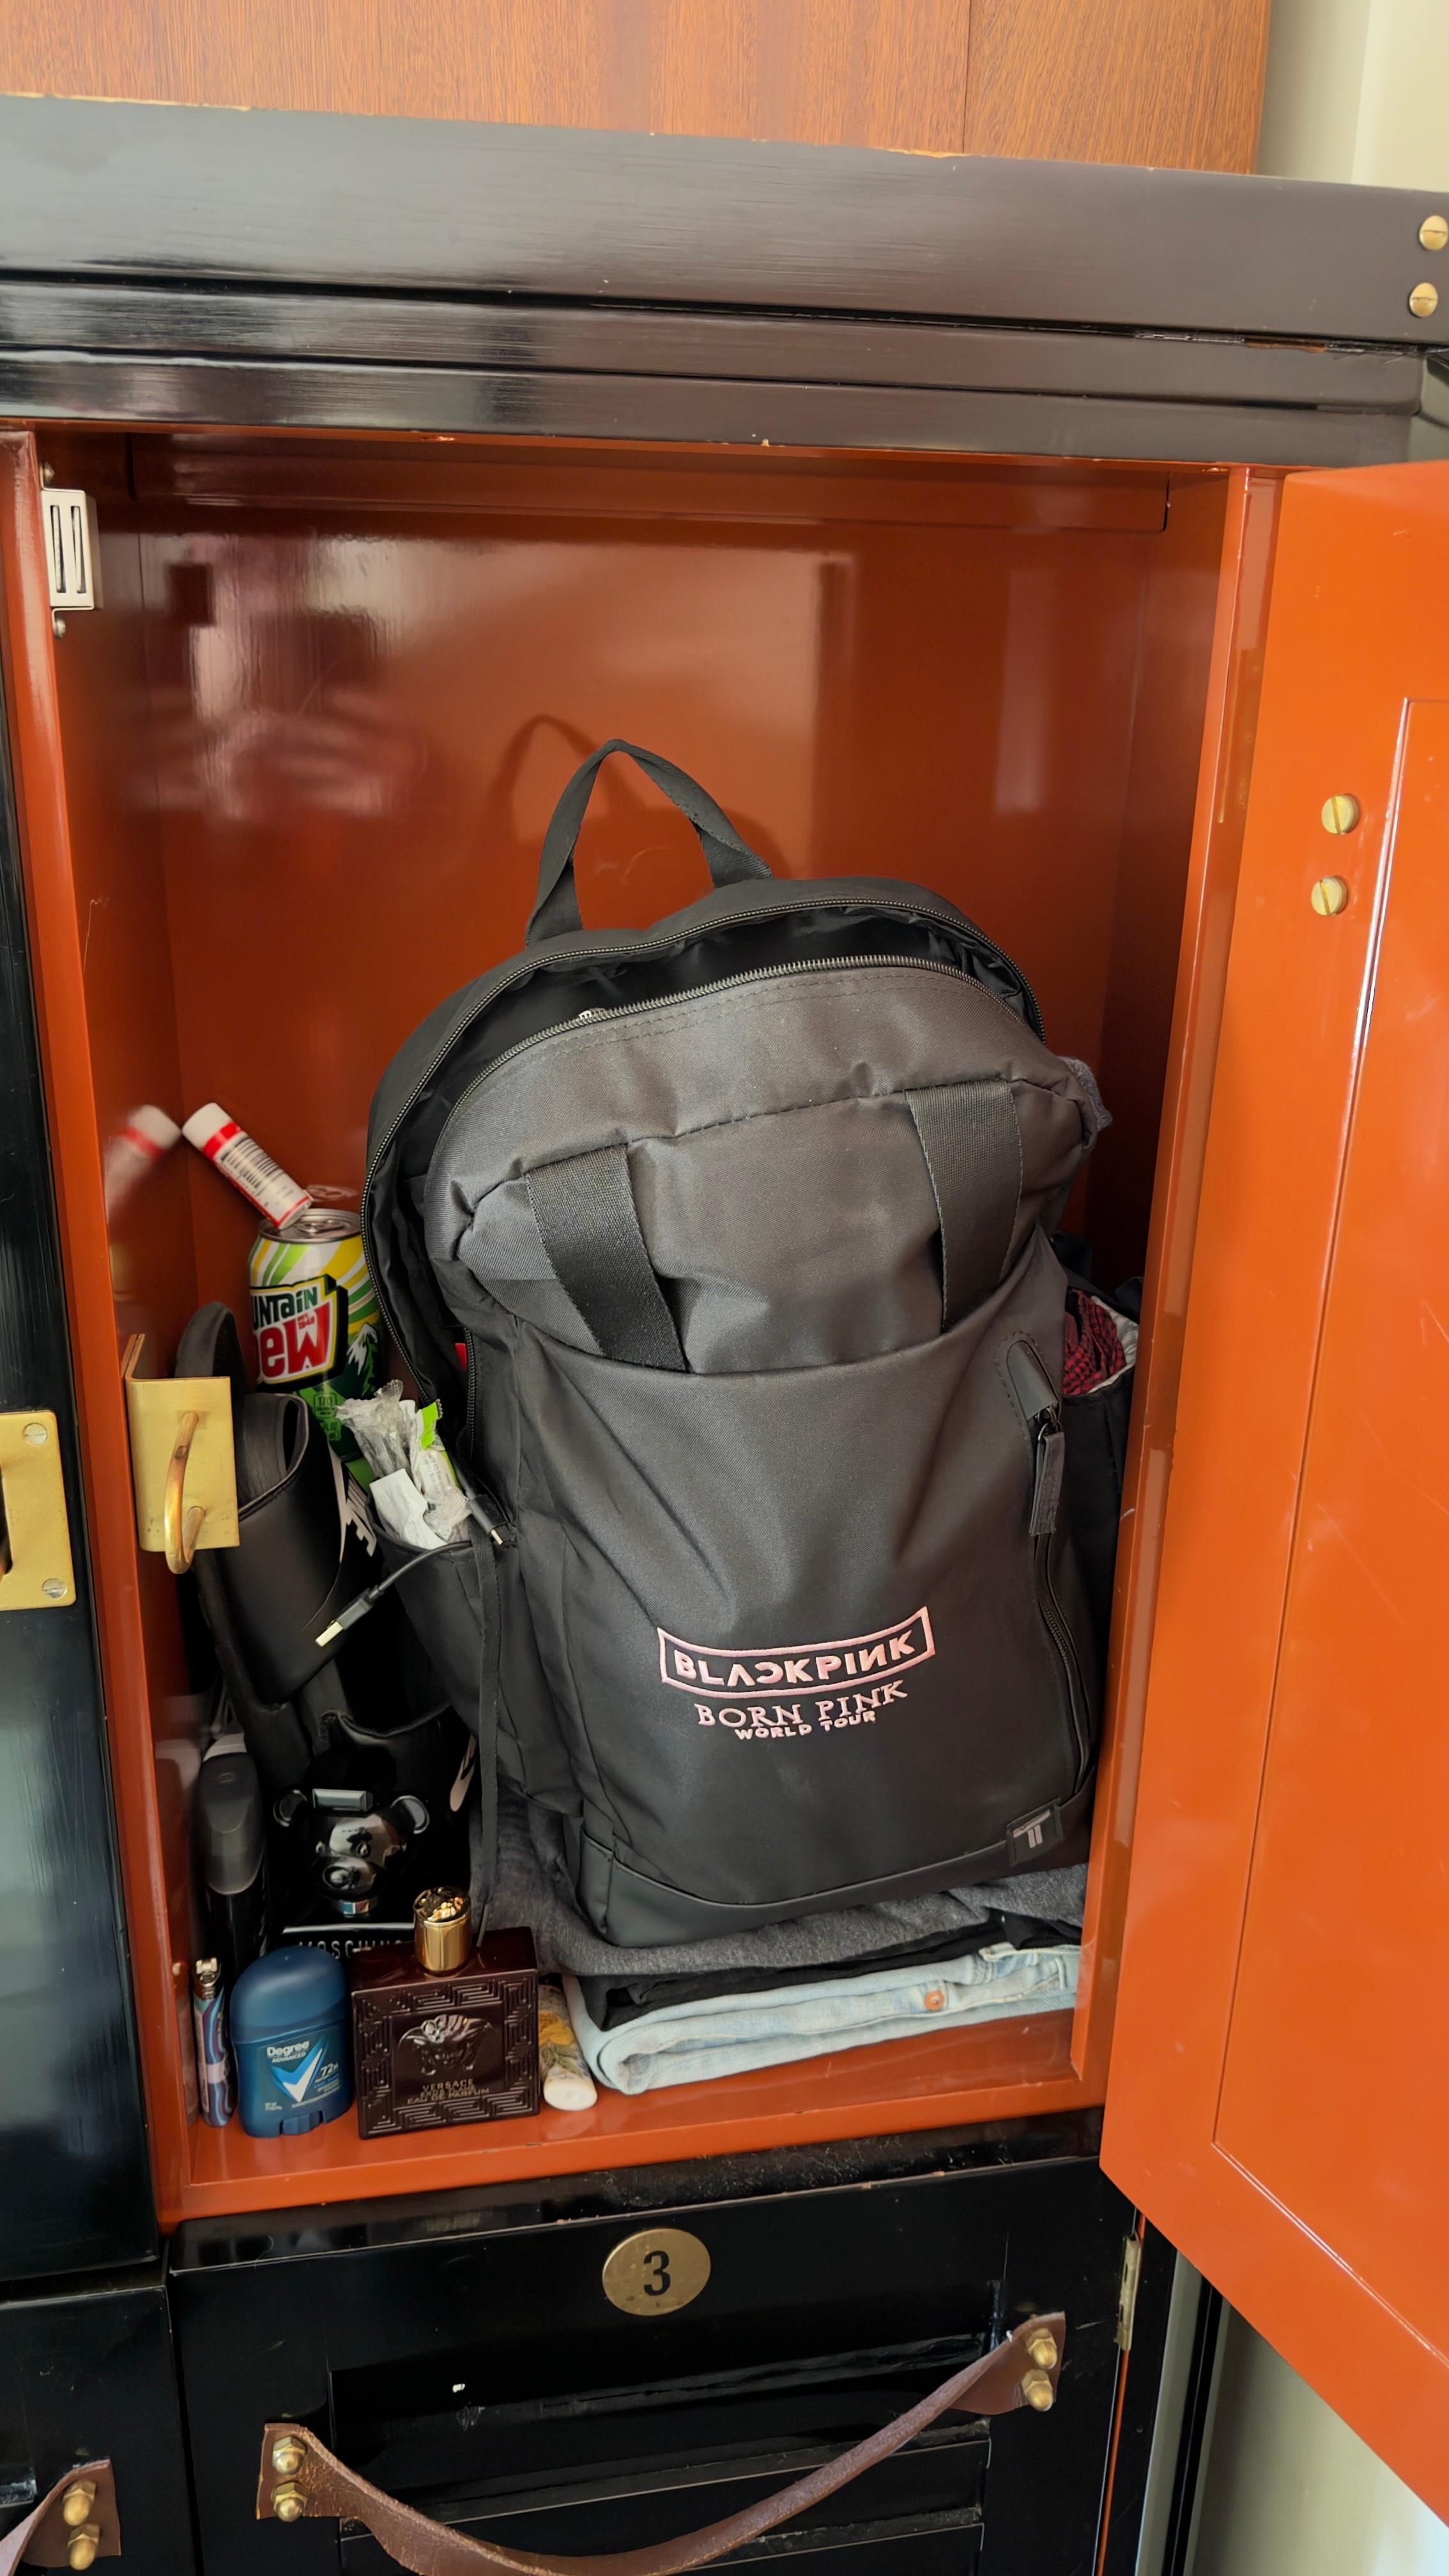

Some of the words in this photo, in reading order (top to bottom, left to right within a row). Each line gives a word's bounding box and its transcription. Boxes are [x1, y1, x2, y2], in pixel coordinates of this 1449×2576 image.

[252, 1286, 318, 1330] UNTaiN
[258, 1301, 330, 1377] eW
[673, 1630, 916, 1687] BLACKPINK
[694, 1703, 804, 1728] BORN
[815, 1680, 908, 1722] PINK
[734, 1724, 813, 1740] WORLD
[820, 1710, 876, 1731] TOUR
[266, 2041, 310, 2057] Degree
[422, 2078, 474, 2092] VERSACE
[643, 2250, 671, 2297] 3
